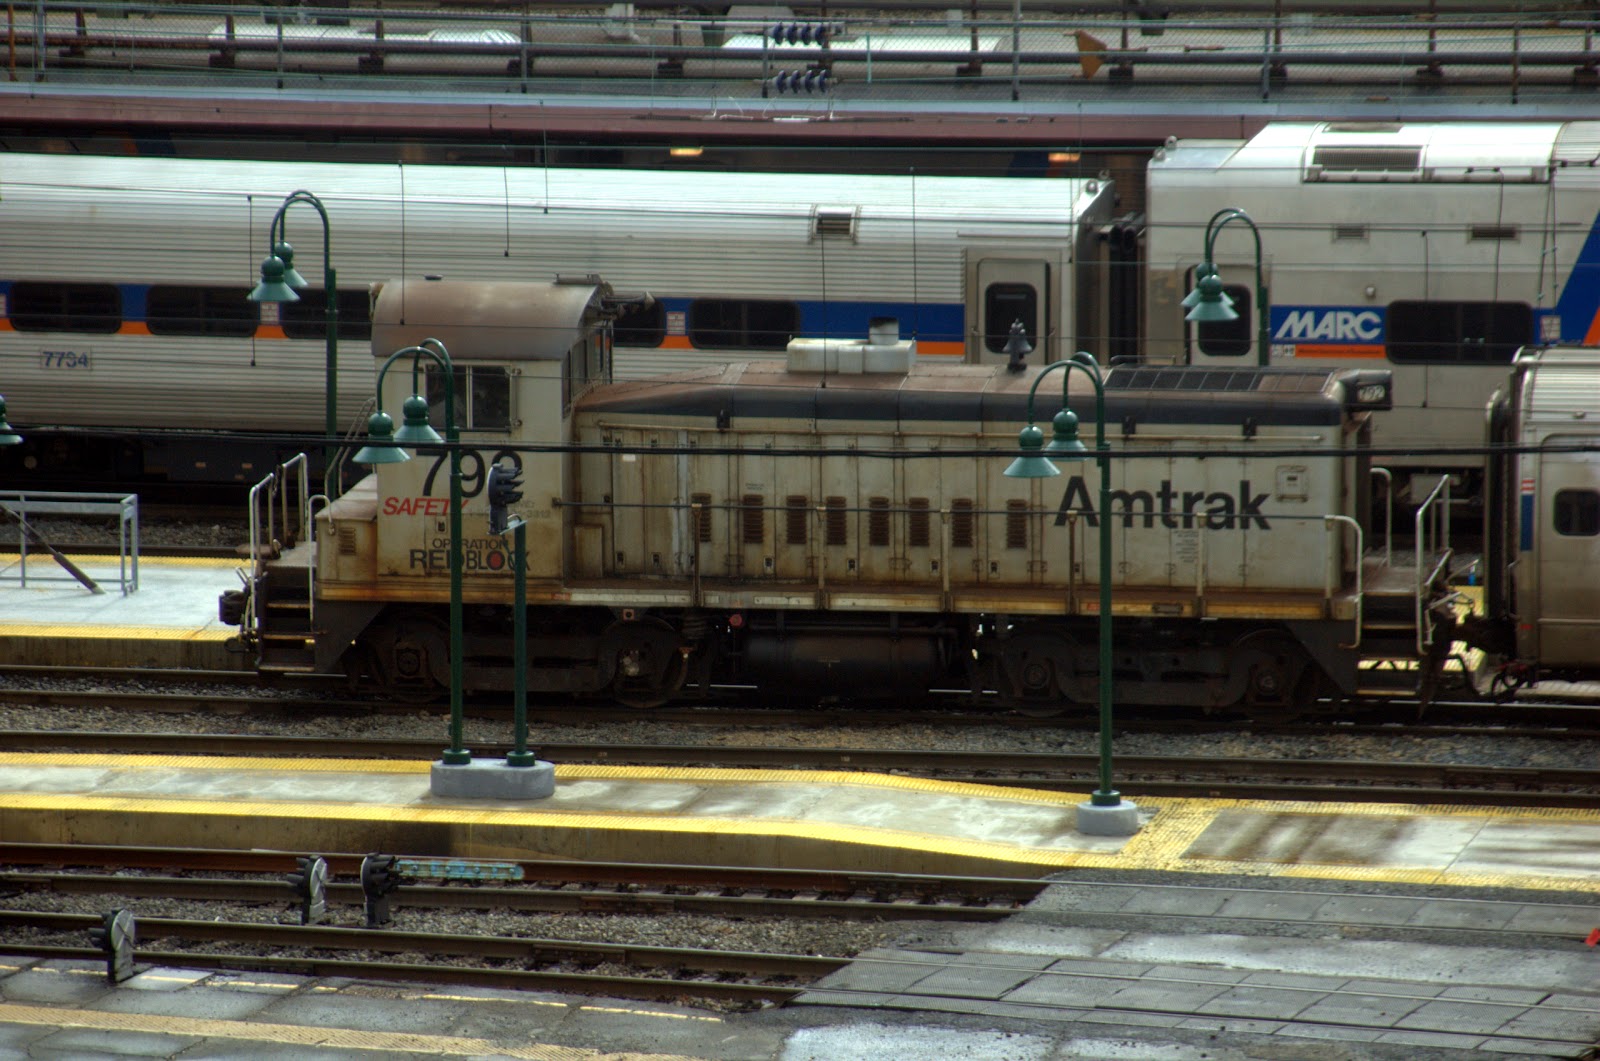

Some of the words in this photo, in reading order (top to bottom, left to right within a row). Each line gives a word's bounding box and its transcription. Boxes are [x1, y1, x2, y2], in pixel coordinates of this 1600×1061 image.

[1274, 310, 1381, 340] MARC
[1053, 475, 1271, 531] Amtrak
[432, 538, 507, 549] OPRATION
